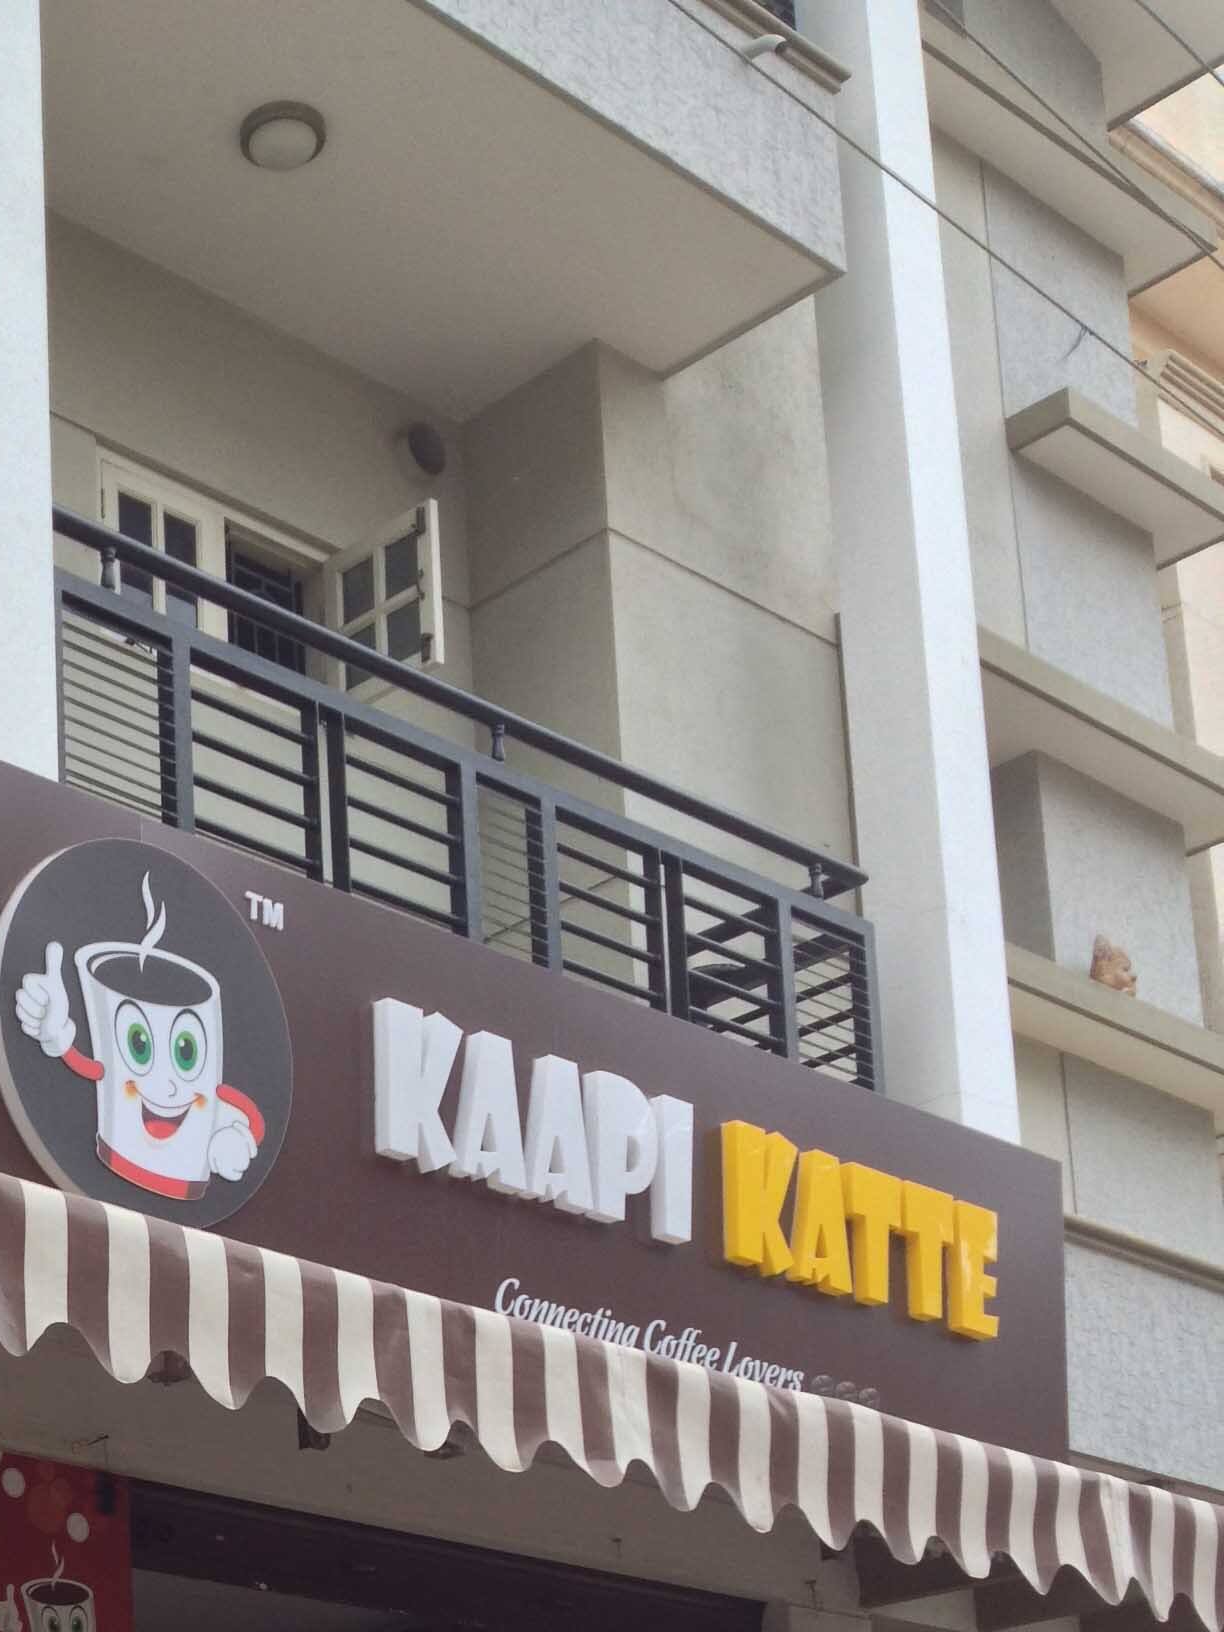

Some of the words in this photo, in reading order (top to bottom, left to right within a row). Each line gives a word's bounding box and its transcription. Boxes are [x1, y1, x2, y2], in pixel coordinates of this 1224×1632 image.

[244, 890, 285, 932] TM
[373, 996, 695, 1246] KAAPI
[721, 1118, 1000, 1342] KATTE
[494, 1276, 641, 1350] Connecting
[642, 1319, 721, 1373] Coffee
[722, 1341, 805, 1393] Lovers
